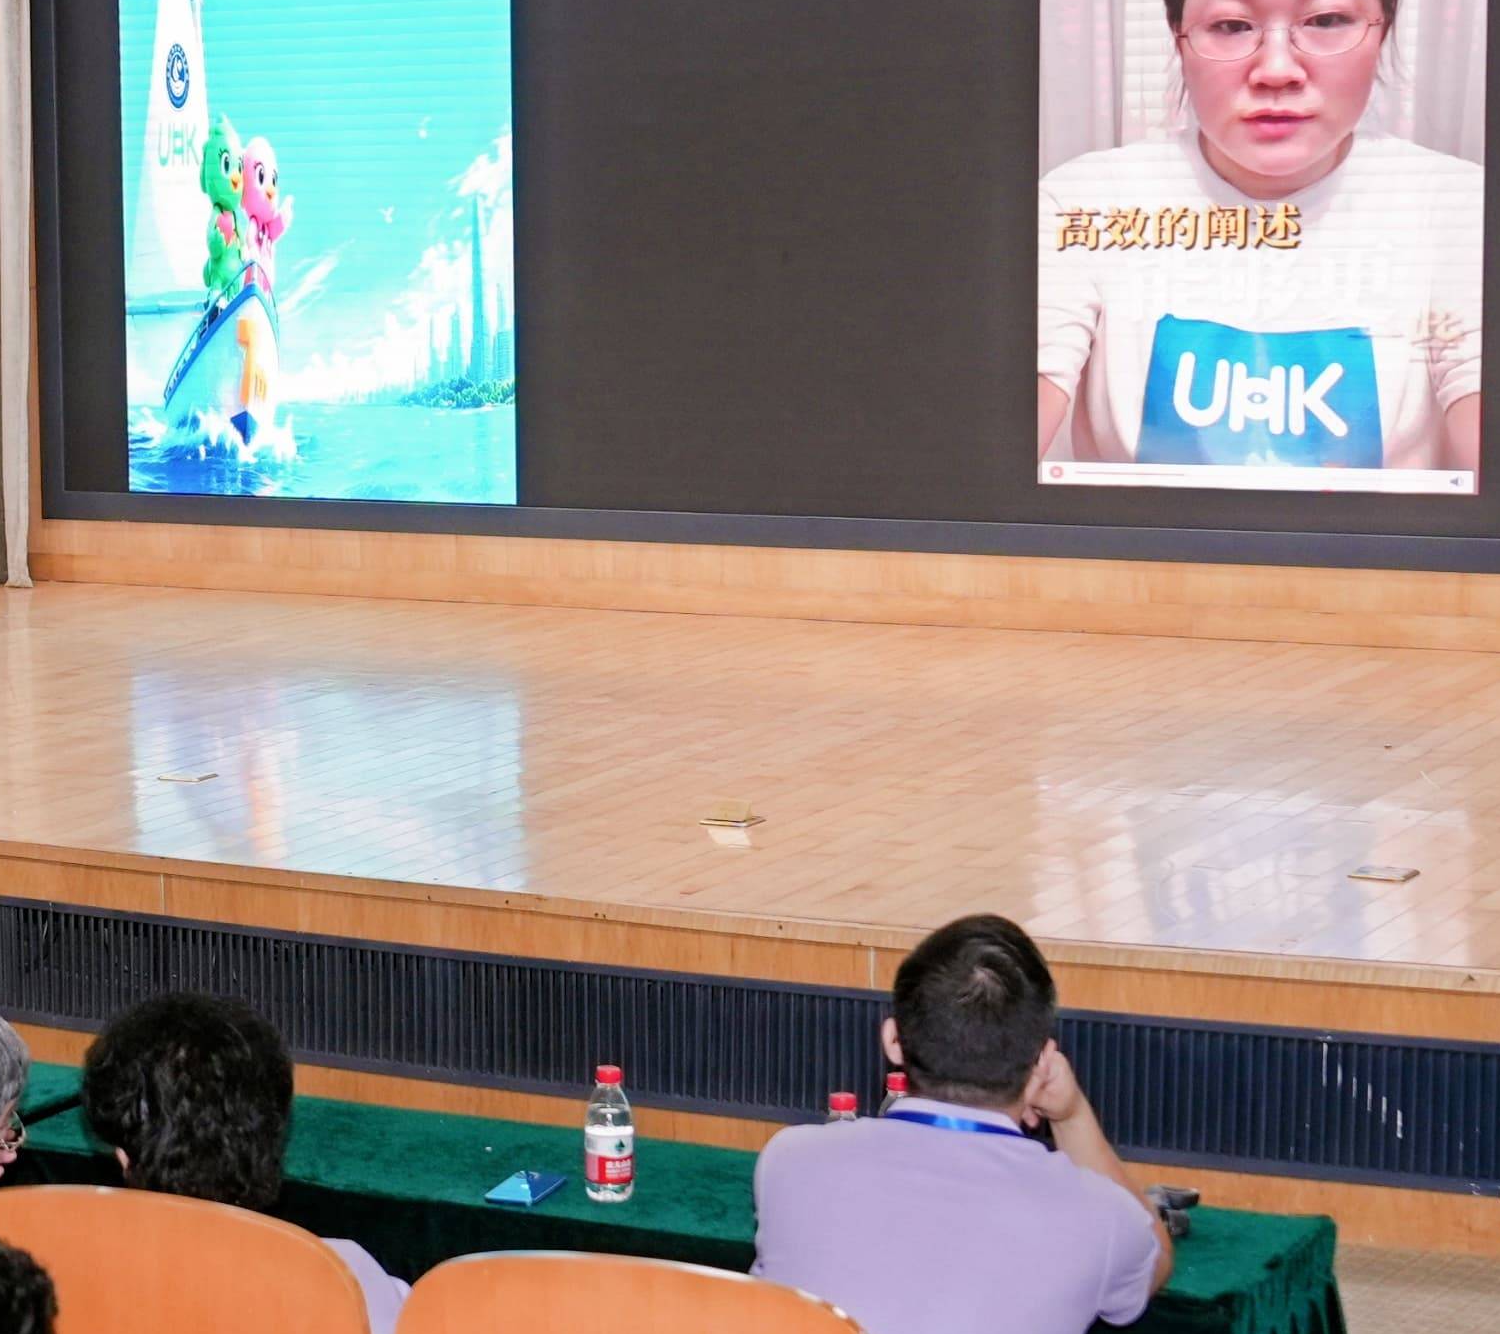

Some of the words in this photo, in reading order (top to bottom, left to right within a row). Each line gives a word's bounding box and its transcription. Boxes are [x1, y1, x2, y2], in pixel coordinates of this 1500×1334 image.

[1055, 203, 1302, 251] 高效的阐述
[1171, 351, 1349, 438] UHK
